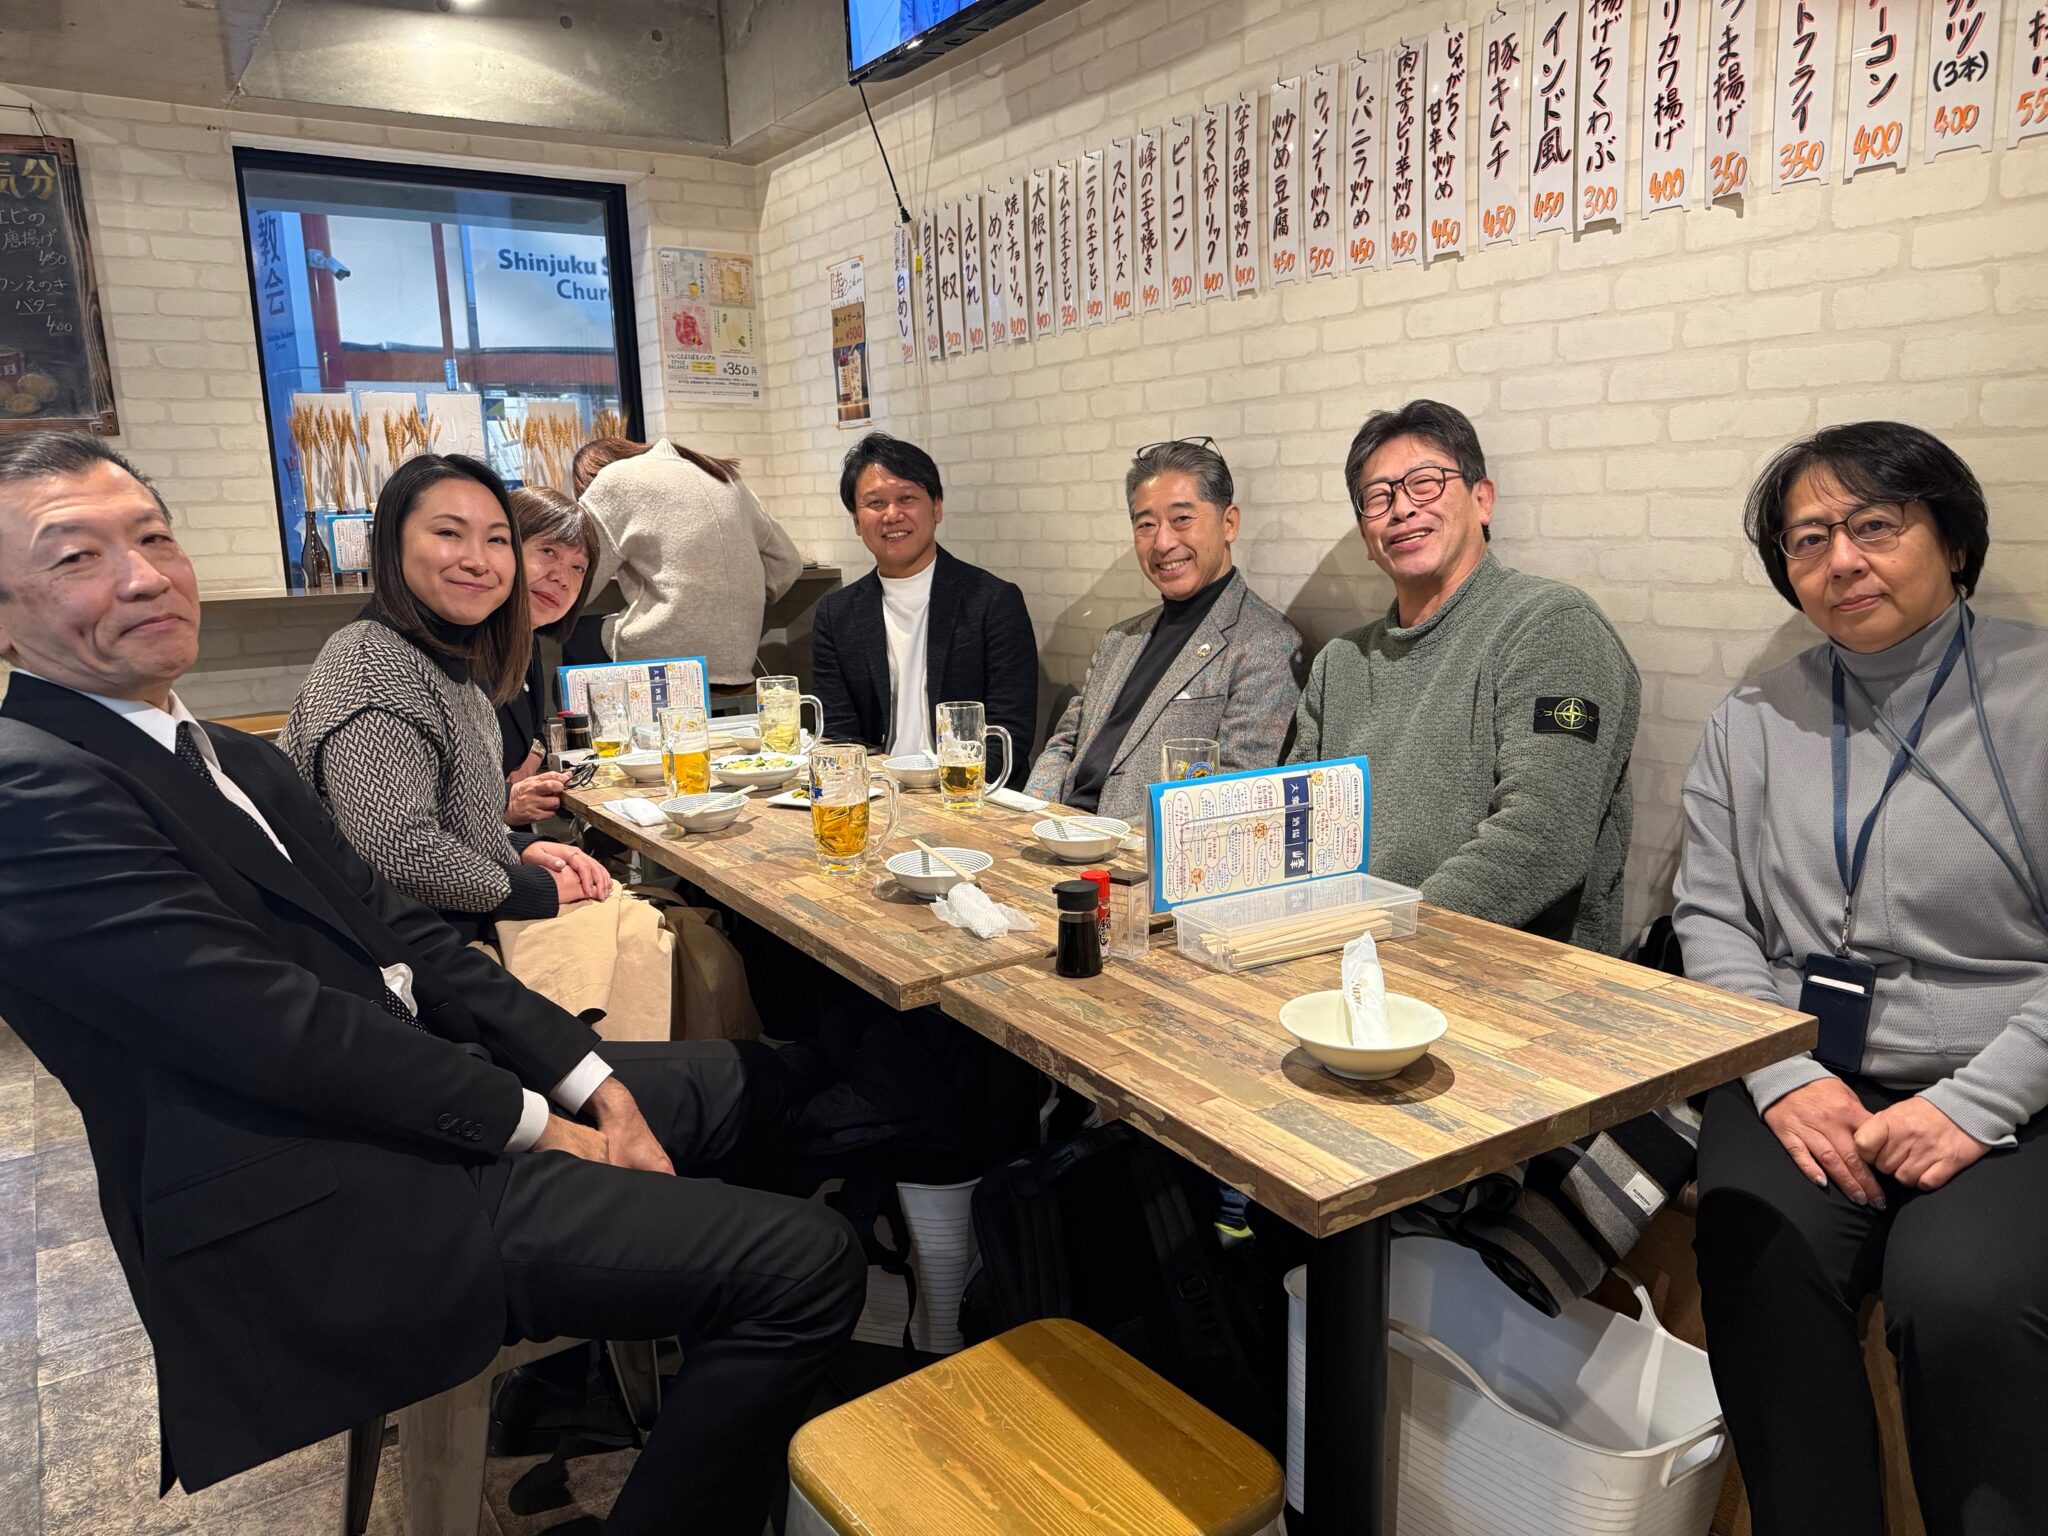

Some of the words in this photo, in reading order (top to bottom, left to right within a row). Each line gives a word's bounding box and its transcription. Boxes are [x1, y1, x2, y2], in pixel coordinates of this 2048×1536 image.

[1789, 1, 1818, 133] トフライ
[1865, 0, 1899, 108] ーコン
[1932, 50, 1989, 92] (3本)
[1445, 31, 1465, 141] じゃがちく
[1487, 32, 1520, 180] 豚キムチ
[1533, 11, 1572, 176] インド風
[1392, 50, 1418, 220] 肉なすピリ辛炒め
[1853, 121, 1902, 164] 400
[1933, 104, 1979, 139] 400
[1310, 87, 1330, 229] ウィンナー炒め
[1349, 76, 1374, 228] レバニラ炒め
[1427, 98, 1455, 200] 甘辛炒め
[1779, 140, 1824, 180] 350
[1172, 135, 1189, 251] ピーコン
[1202, 117, 1220, 265] ちくわガーリック
[1232, 103, 1252, 259] なすの油味噌炒め
[1272, 108, 1296, 240] 炒め豆腐
[1649, 167, 1684, 204] 400
[1710, 151, 1747, 196] 350
[1111, 159, 1127, 282] スパムチーズ
[1138, 141, 1158, 276] 峰の玉子焼き
[1482, 204, 1515, 238] 450
[1533, 191, 1564, 222] 450
[1582, 185, 1617, 220] 300
[3, 229, 57, 250] 唐揚げ
[1031, 182, 1048, 307] 大根サラダ
[1058, 172, 1072, 302] キムチ玉子とじ
[1085, 164, 1098, 292] ニラの玉子とじ
[1391, 230, 1417, 255] 450
[1431, 217, 1460, 249] 450
[38, 250, 66, 266] 450
[256, 210, 285, 316] 教会
[498, 248, 597, 277] Shinjuku
[939, 226, 958, 301] 冷奴
[964, 217, 980, 306] えいひれ
[1273, 252, 1296, 273] 450
[1308, 247, 1335, 274] 500
[1350, 238, 1375, 264] 450
[556, 278, 611, 301] Chur
[1171, 275, 1192, 300] 300
[1203, 271, 1224, 294] 400
[1235, 264, 1256, 286] 400
[15, 299, 56, 313] バター
[897, 274, 909, 337] 白めし
[1061, 305, 1077, 327] 350
[1113, 290, 1131, 311] 400
[46, 314, 73, 333] 400
[1009, 317, 1026, 337] 400
[1037, 312, 1051, 334] 400
